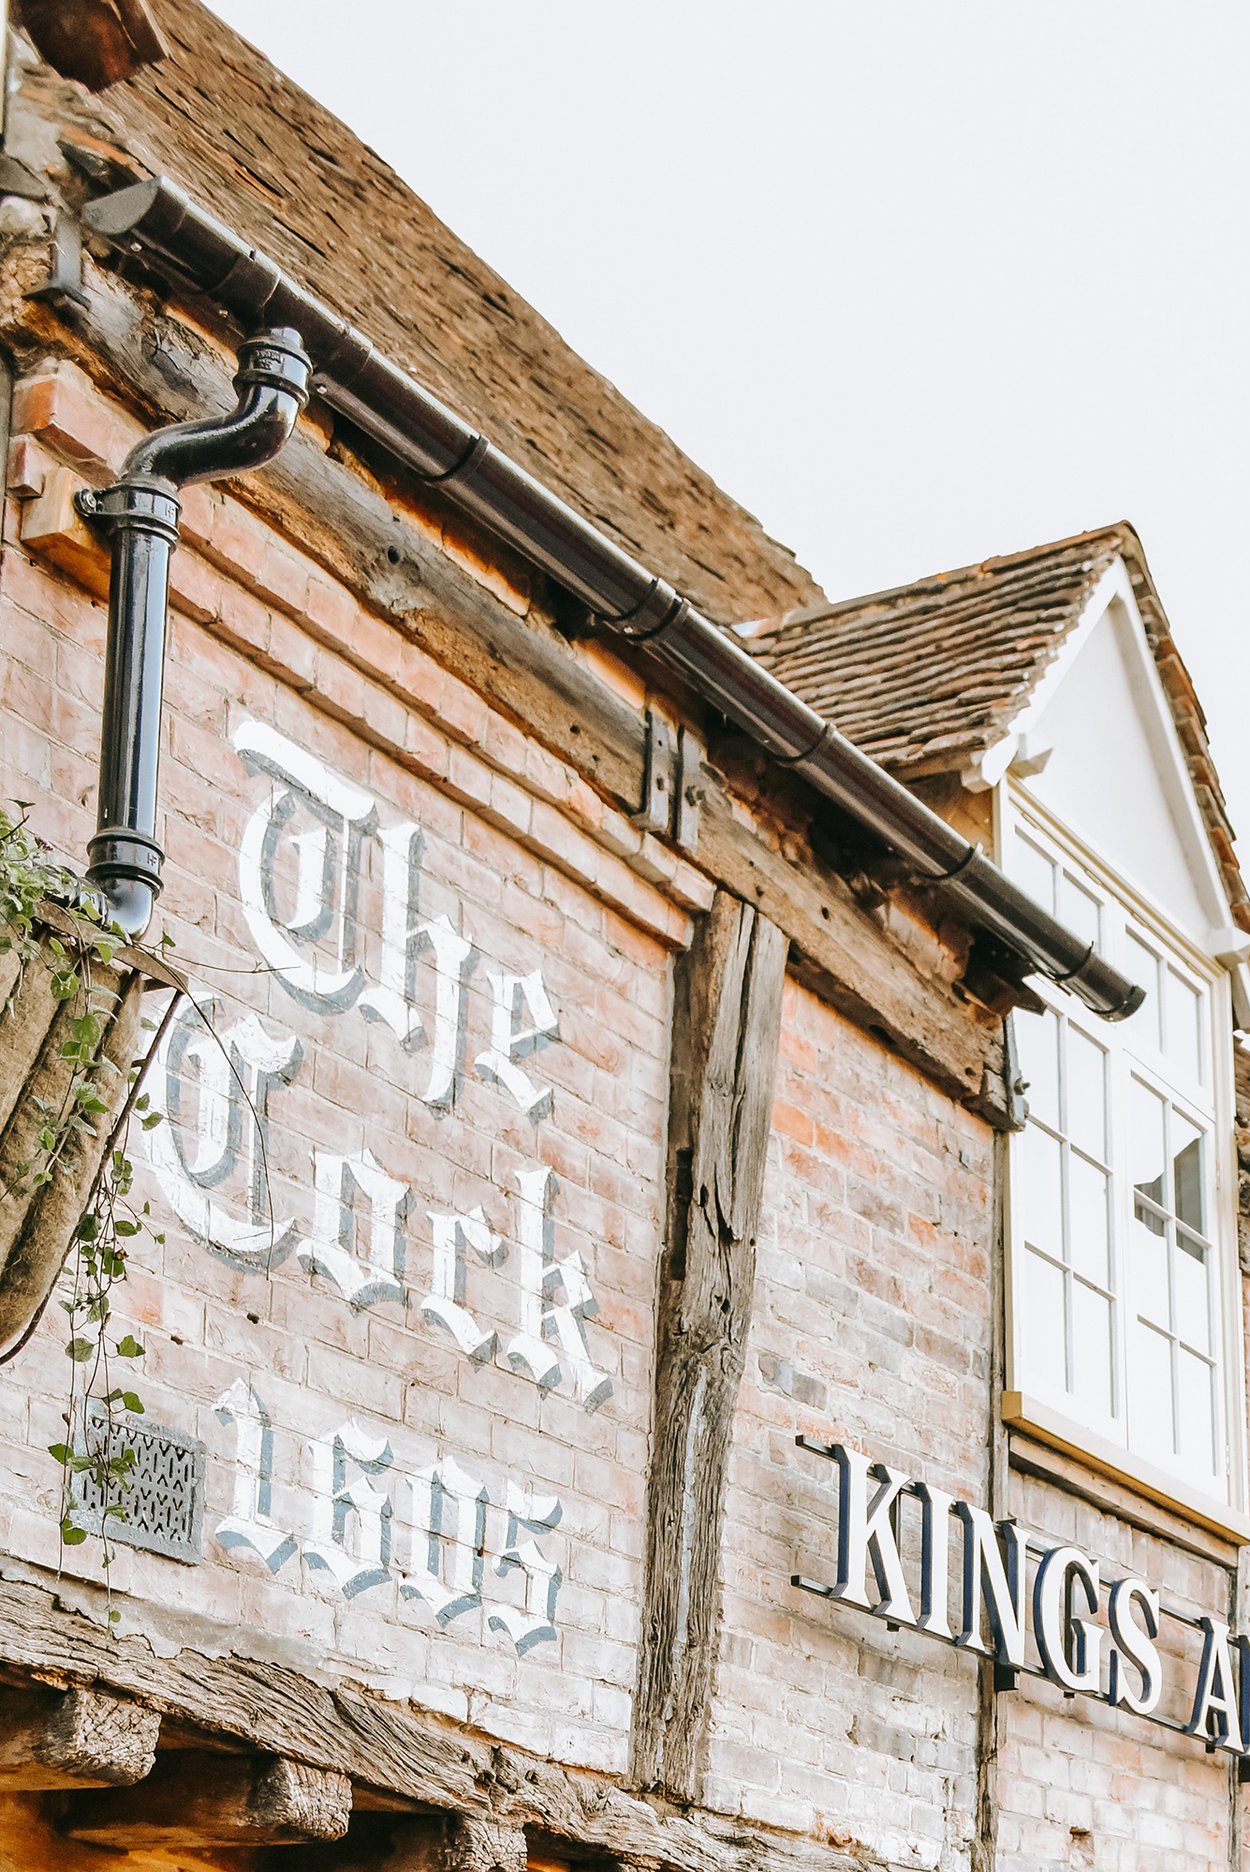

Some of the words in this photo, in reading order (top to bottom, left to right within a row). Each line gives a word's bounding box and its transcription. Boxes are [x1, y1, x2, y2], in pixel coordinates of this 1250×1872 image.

[233, 720, 559, 1124] The
[211, 1377, 564, 1656] 1605
[831, 1443, 1163, 1716] KINGS
